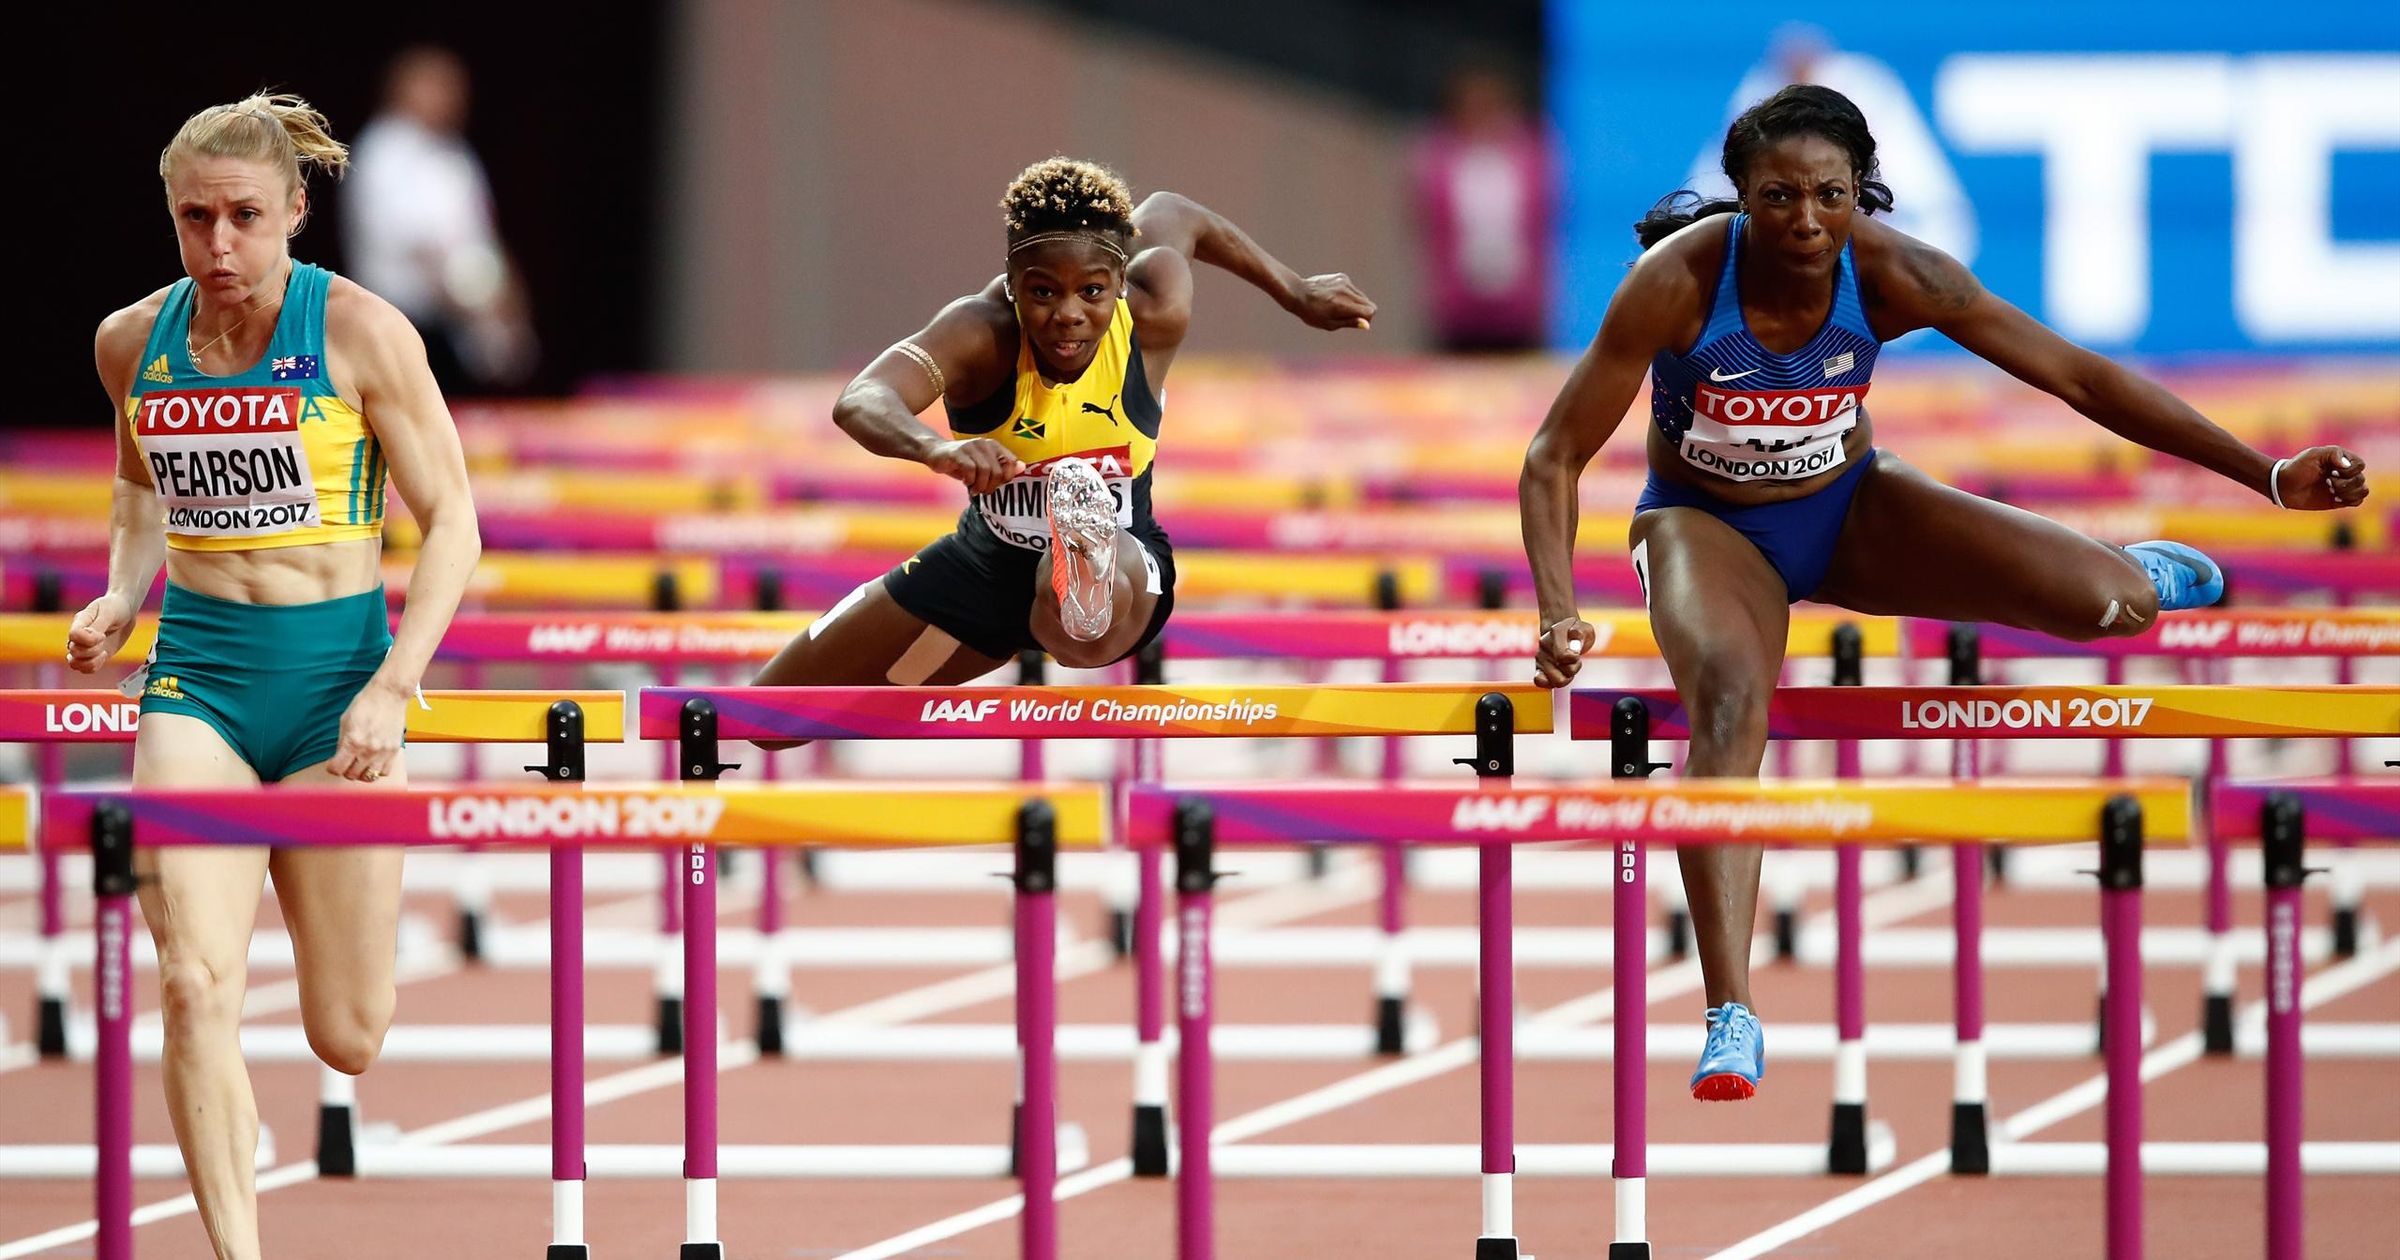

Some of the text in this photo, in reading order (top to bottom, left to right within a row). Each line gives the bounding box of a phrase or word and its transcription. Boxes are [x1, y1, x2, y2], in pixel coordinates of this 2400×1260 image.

[143, 371, 173, 384] adidas
[144, 395, 291, 429] TOYOTA
[1701, 389, 1858, 422] TOYOTA
[150, 446, 302, 497] PEARSON
[1687, 444, 1789, 477] LONDON
[169, 502, 311, 529] LONDON 2017
[147, 686, 184, 700] adidas
[920, 698, 1278, 727] IAAF World Championships
[1902, 697, 2155, 729] LONDON 2017
[428, 796, 725, 838] LONDON 2017
[1452, 796, 1874, 834] IAAF World Championships
